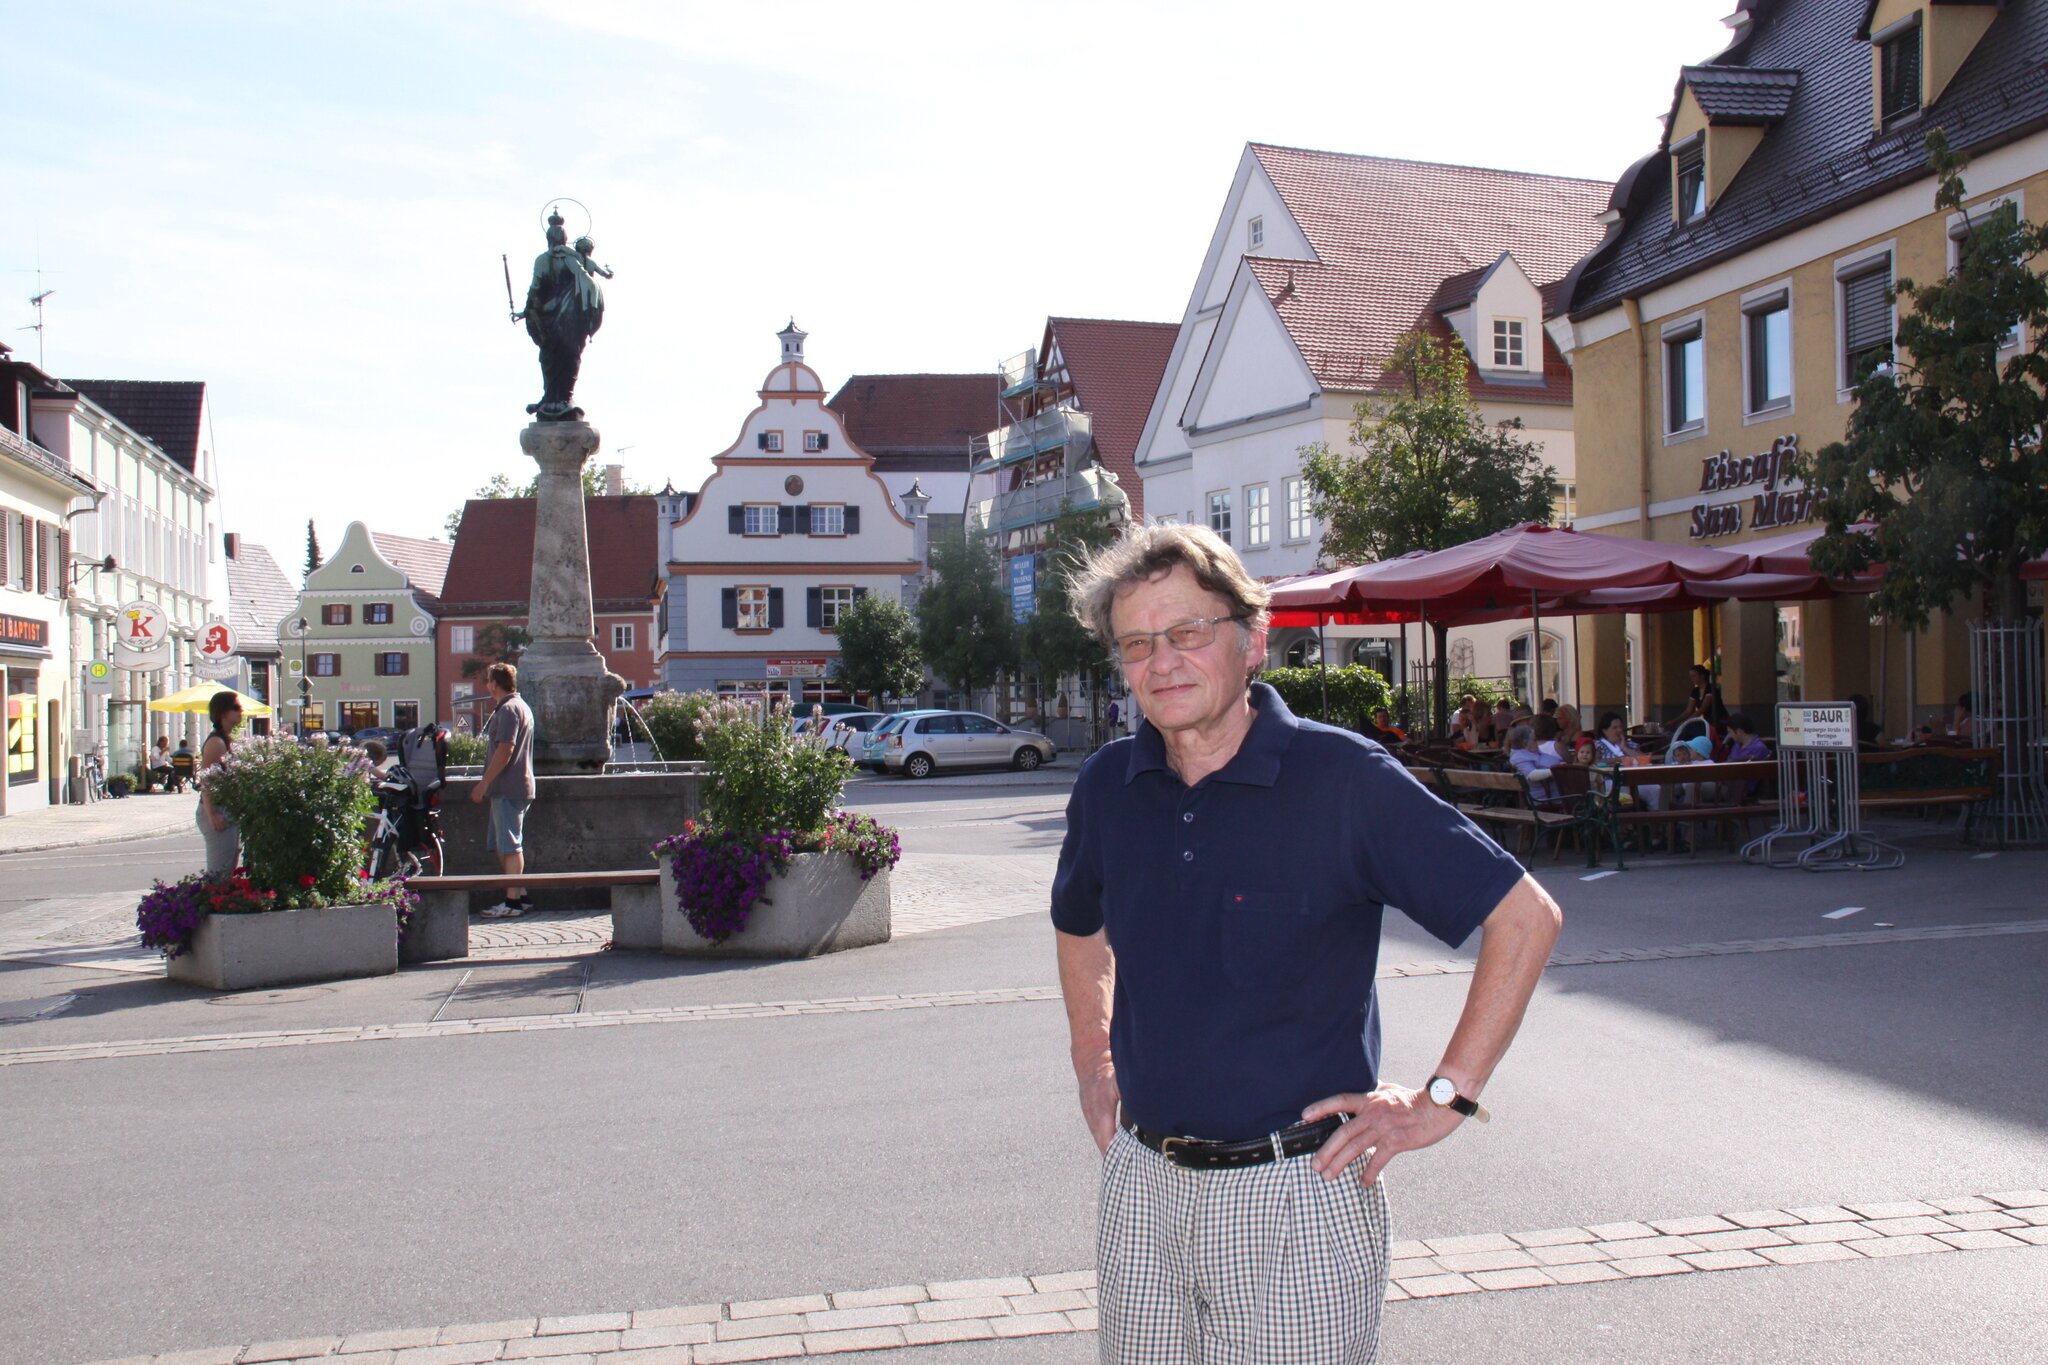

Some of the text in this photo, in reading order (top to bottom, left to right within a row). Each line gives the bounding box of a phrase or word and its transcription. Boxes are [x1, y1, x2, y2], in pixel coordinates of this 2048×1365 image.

[1699, 432, 1798, 493] Eiscafé
[1689, 502, 1741, 539] San
[8, 618, 40, 641] BAPTIST
[130, 616, 153, 637] K
[1813, 710, 1843, 723] BAUR
